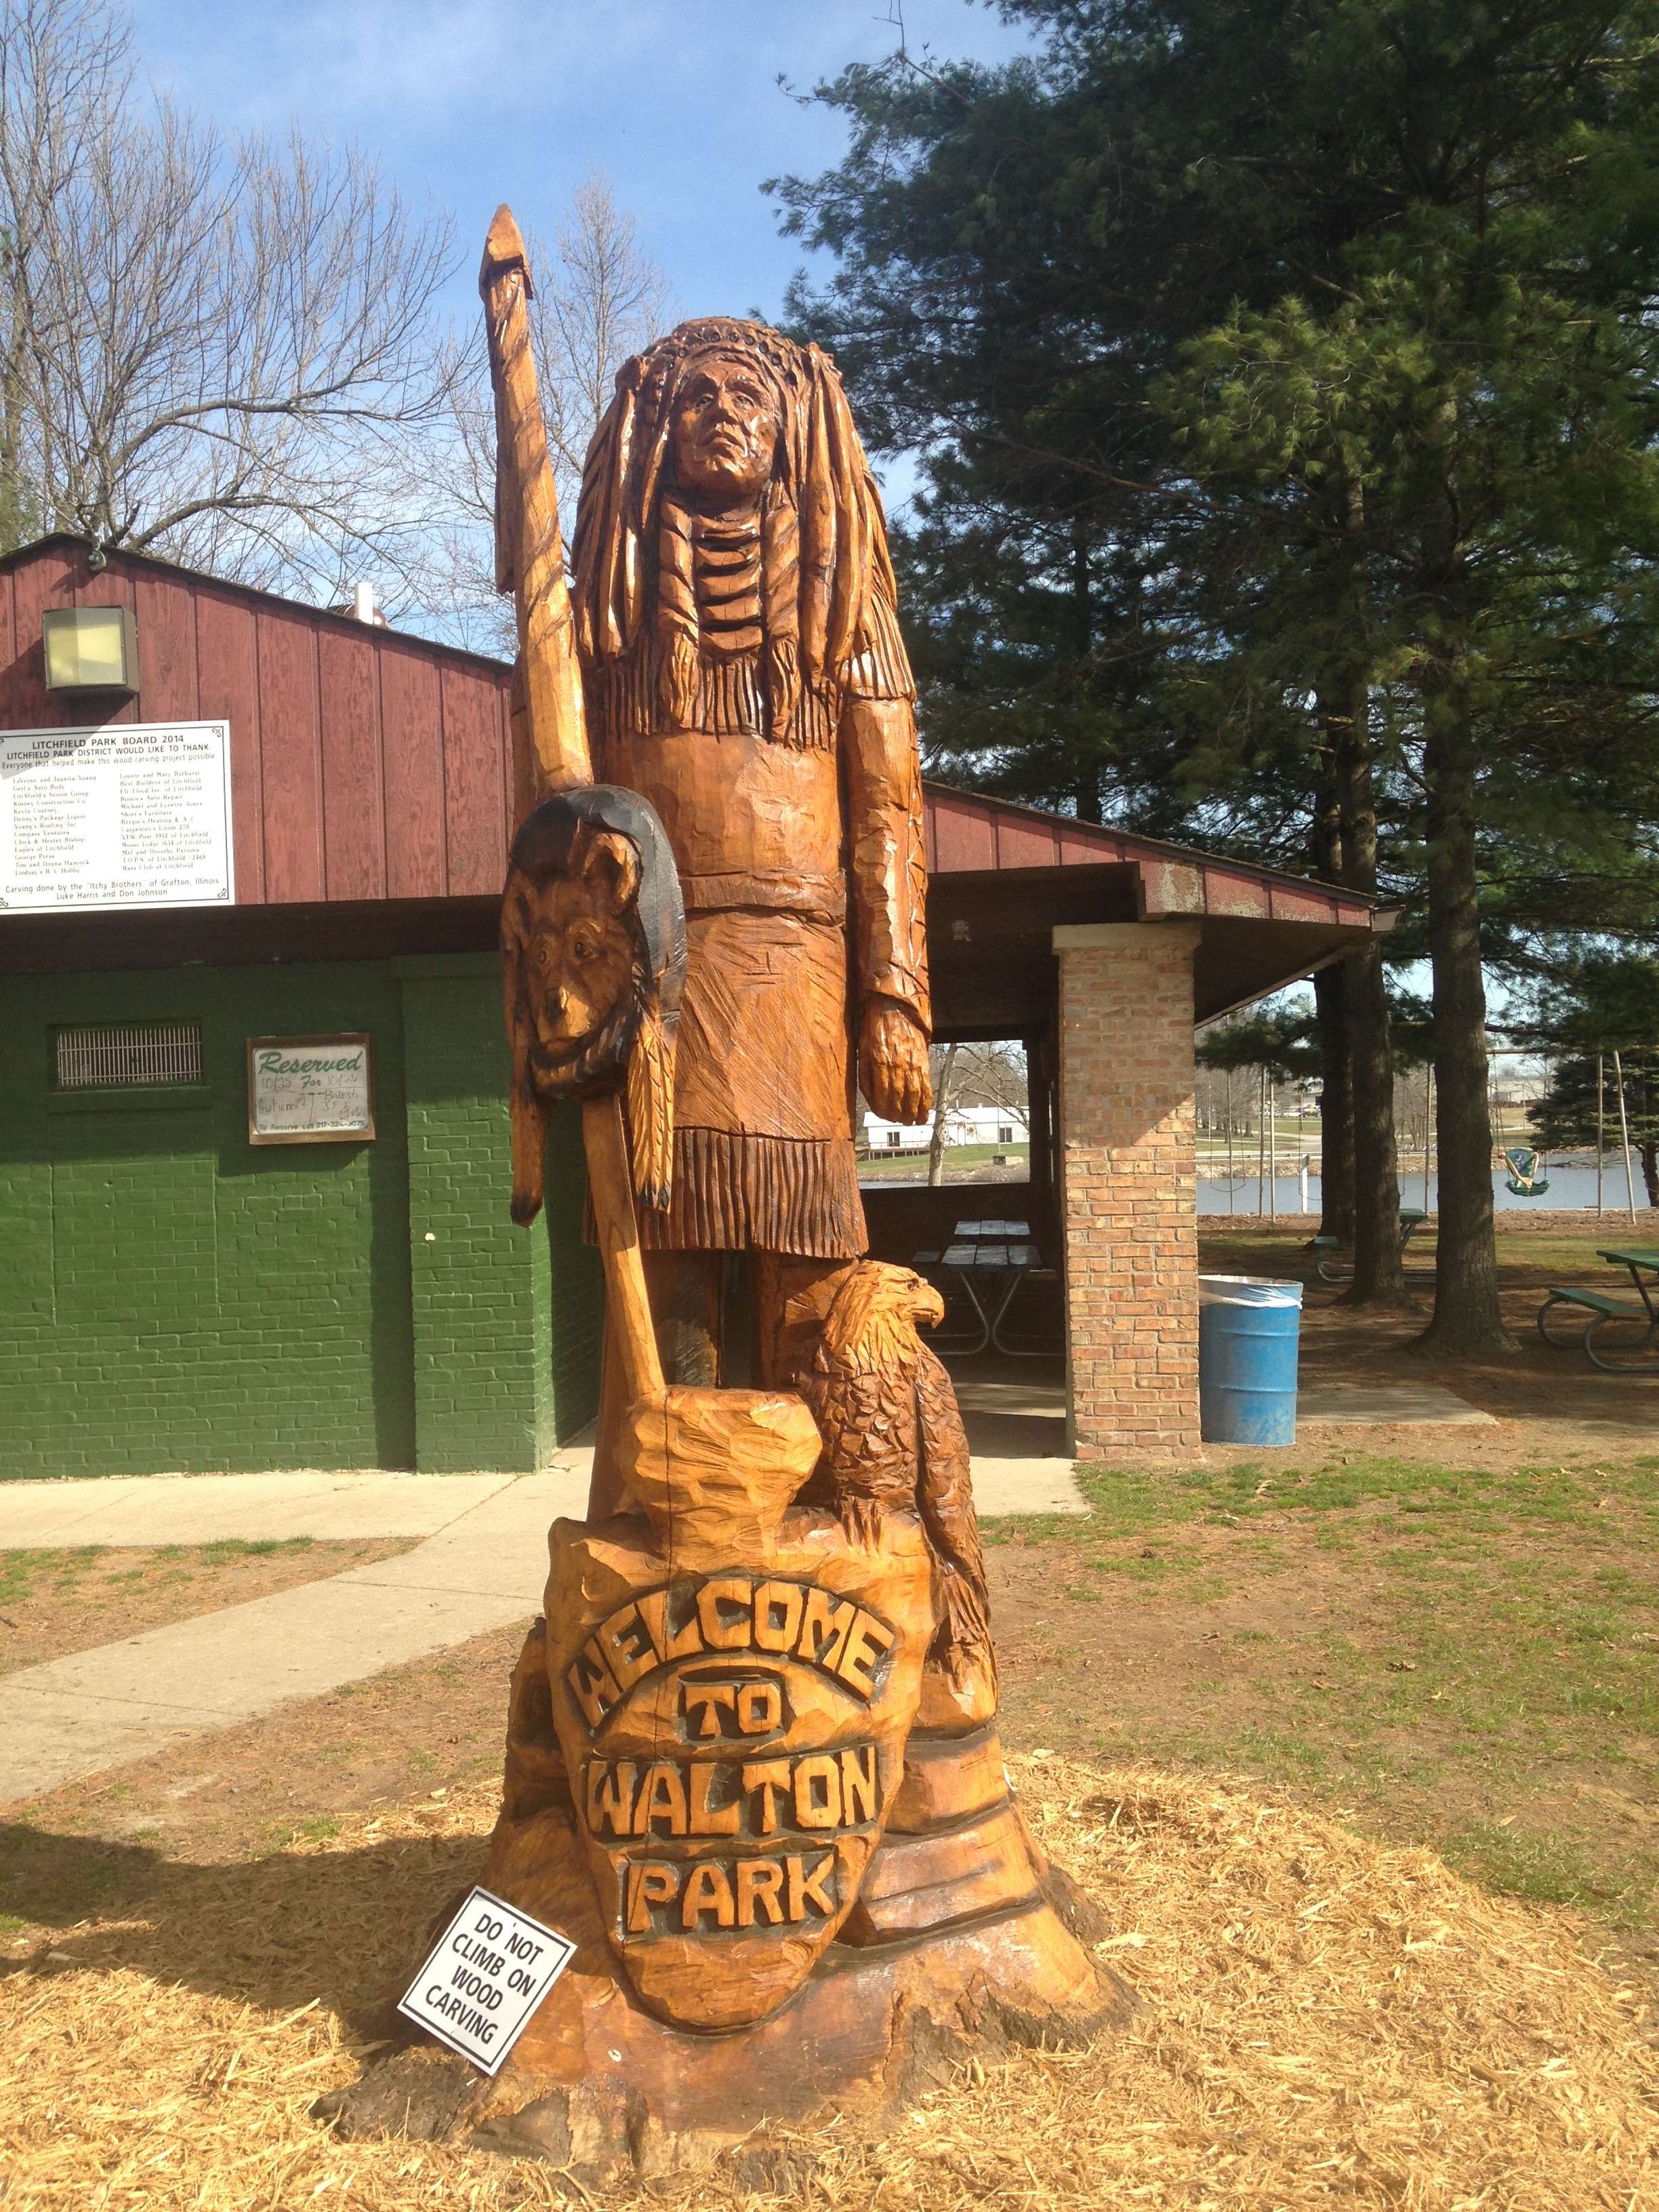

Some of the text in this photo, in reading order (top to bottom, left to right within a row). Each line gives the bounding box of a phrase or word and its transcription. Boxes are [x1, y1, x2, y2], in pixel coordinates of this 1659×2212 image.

[2, 762, 33, 770] Everyone
[52, 759, 74, 767] helped
[136, 755, 159, 764] carving
[163, 754, 185, 763] project
[7, 751, 49, 760] LITCHFIELD
[78, 748, 111, 756] DISTRICT
[183, 743, 209, 752] THANK
[33, 739, 86, 749] LITCHFIELD
[92, 738, 117, 746] PARK
[123, 736, 157, 745] BOARD
[5, 885, 33, 894] Carving
[37, 884, 54, 892] done
[58, 883, 66, 892] by
[150, 878, 157, 887] of
[195, 876, 218, 884] Illinois
[119, 889, 134, 897] Don
[138, 888, 167, 897] Johnson
[258, 1051, 363, 1074] Reserved
[301, 1075, 322, 1089] For
[568, 1580, 894, 1729] WELCOME
[685, 1683, 781, 1736] TO
[588, 1745, 876, 1835] WALTON
[627, 1852, 835, 1931] PARK
[474, 1913, 544, 1965] DO NOT
[451, 1965, 504, 2011] WOOD
[452, 1933, 537, 1997] CLIMB ON
[425, 1985, 499, 2045] CARVING
